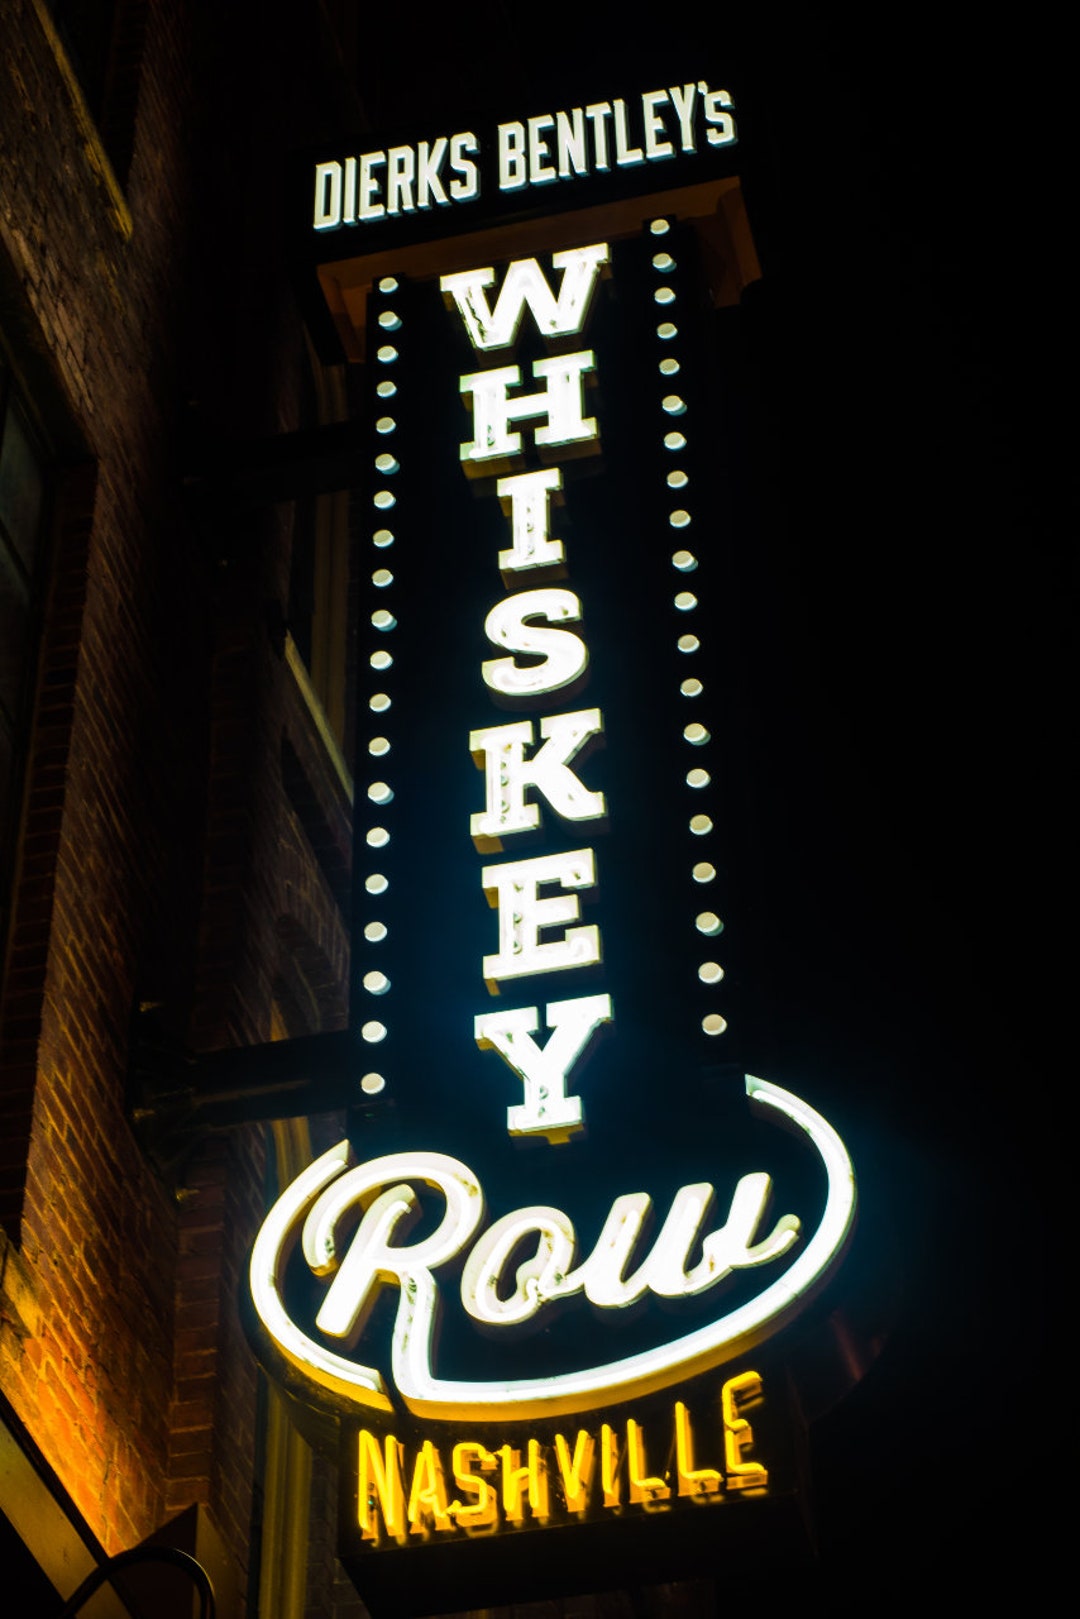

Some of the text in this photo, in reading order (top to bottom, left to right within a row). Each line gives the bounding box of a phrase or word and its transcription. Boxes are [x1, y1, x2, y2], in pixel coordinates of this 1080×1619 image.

[313, 131, 480, 232] DIERKS
[440, 243, 613, 1135] WHISKEY
[302, 1151, 801, 1402] Row
[357, 1371, 769, 1542] NASHVILLE
